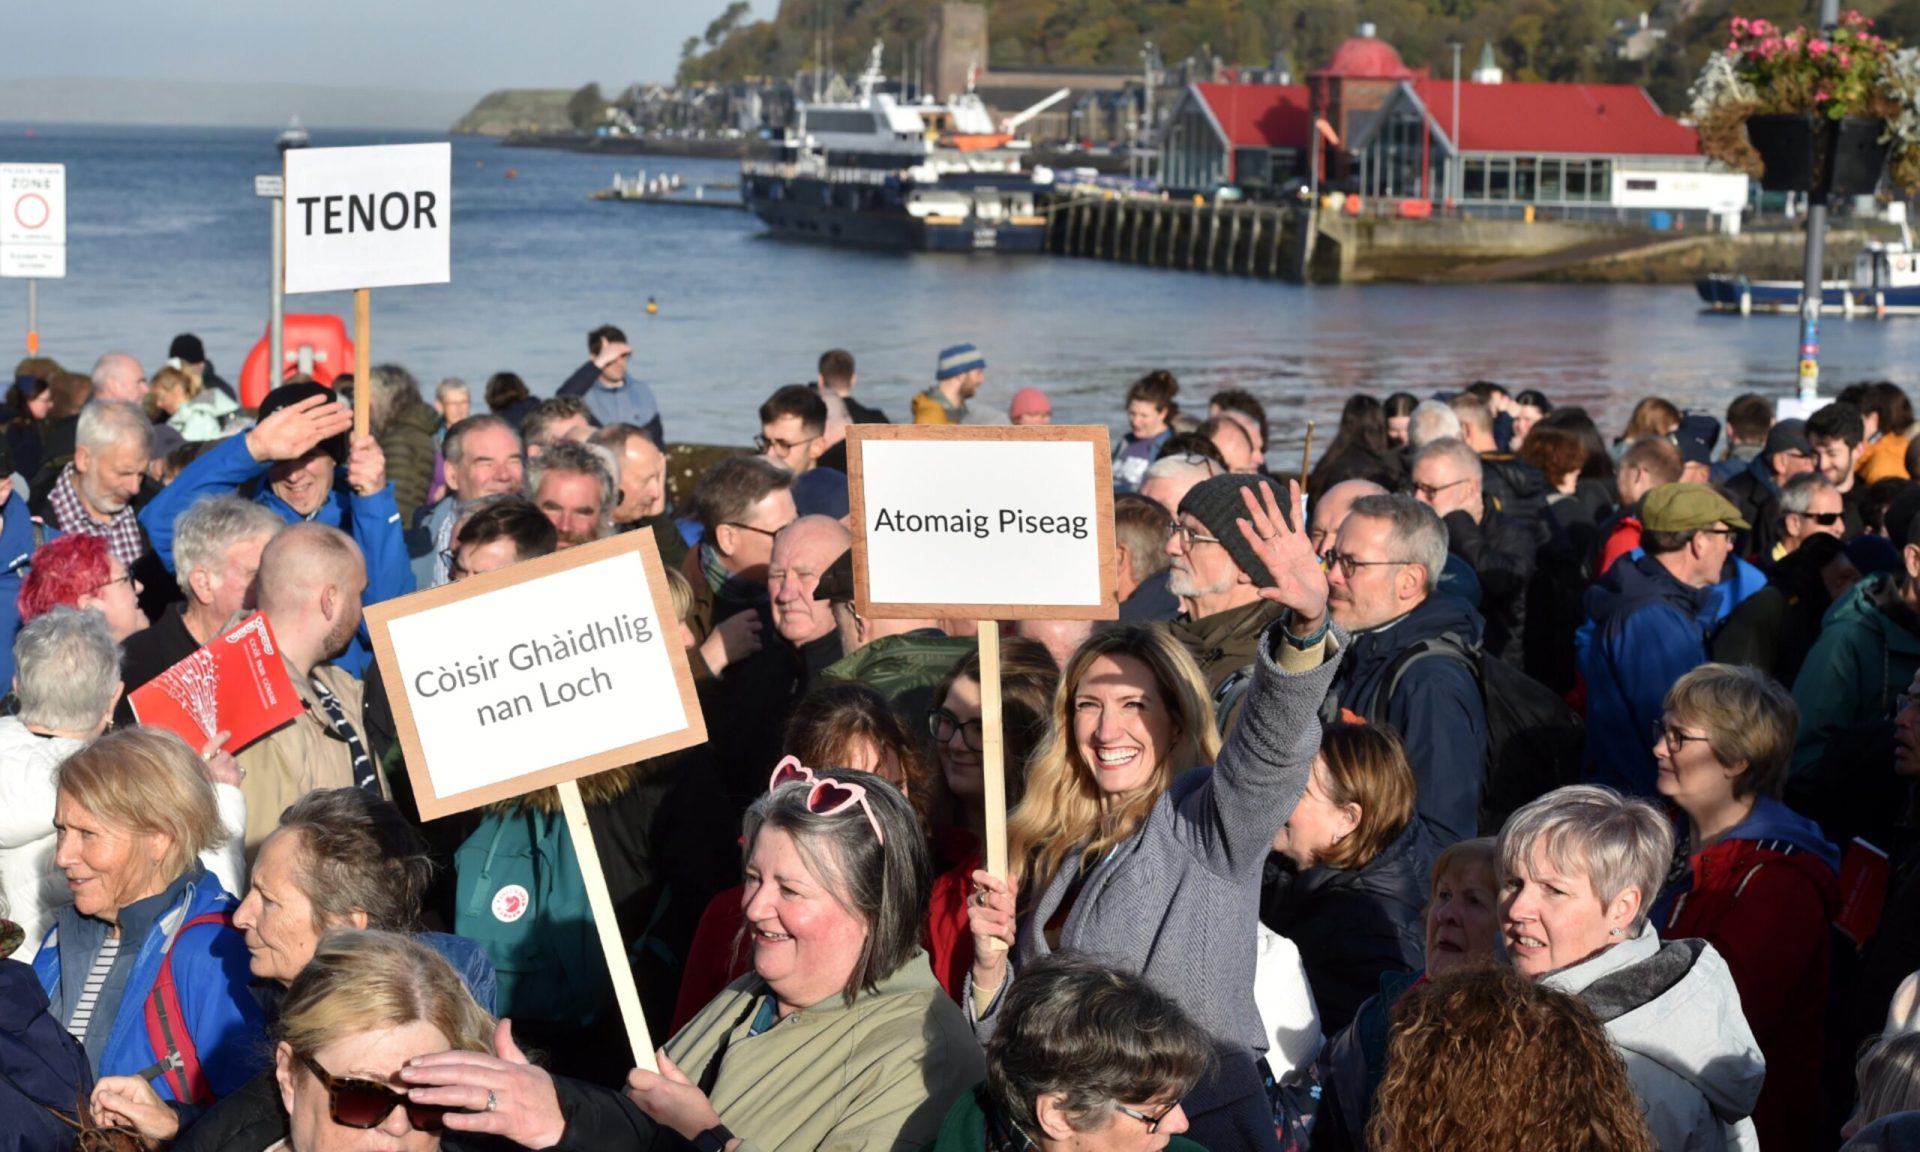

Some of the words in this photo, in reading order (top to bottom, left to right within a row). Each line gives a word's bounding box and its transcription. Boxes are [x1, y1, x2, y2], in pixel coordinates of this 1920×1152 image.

[297, 191, 437, 236] TENOR
[874, 507, 989, 538] Atomaig
[999, 509, 1088, 539] Piseag
[415, 655, 499, 697] Còisir
[508, 614, 653, 671] Ghàidhlig
[476, 694, 534, 726] nan
[540, 666, 612, 707] Loch
